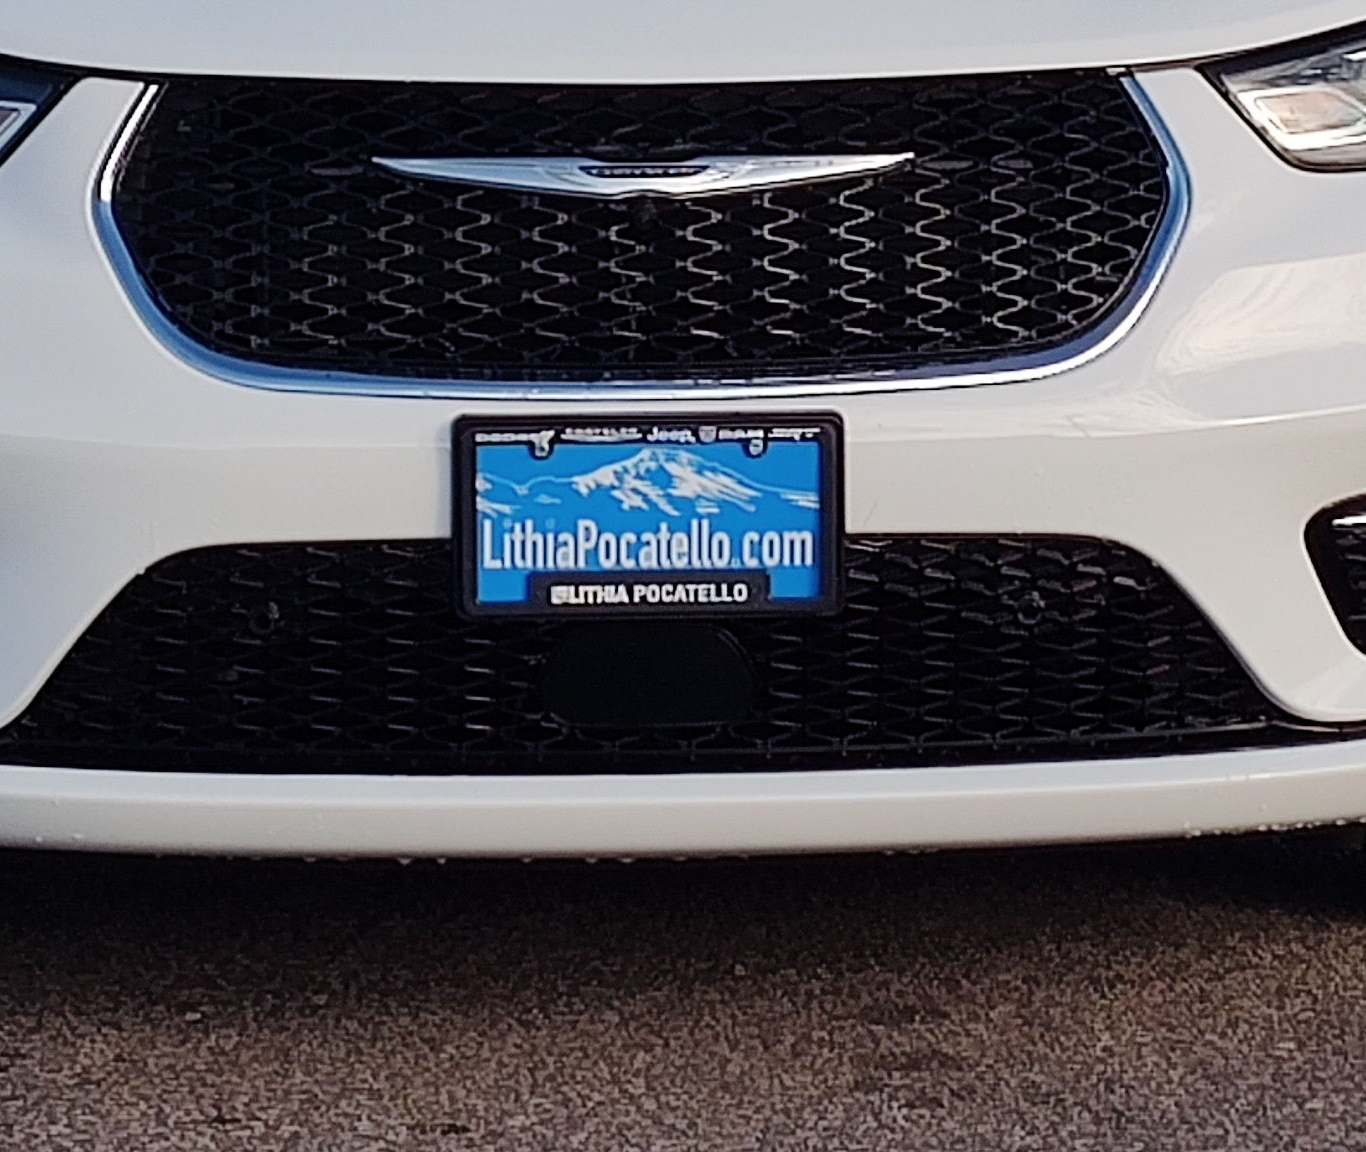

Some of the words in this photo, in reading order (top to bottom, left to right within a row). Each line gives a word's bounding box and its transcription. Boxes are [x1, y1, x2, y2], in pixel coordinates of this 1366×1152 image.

[482, 518, 813, 570] LithiaPocatello.com
[570, 584, 630, 605] LITHIA
[634, 583, 749, 603] POCATELLO
